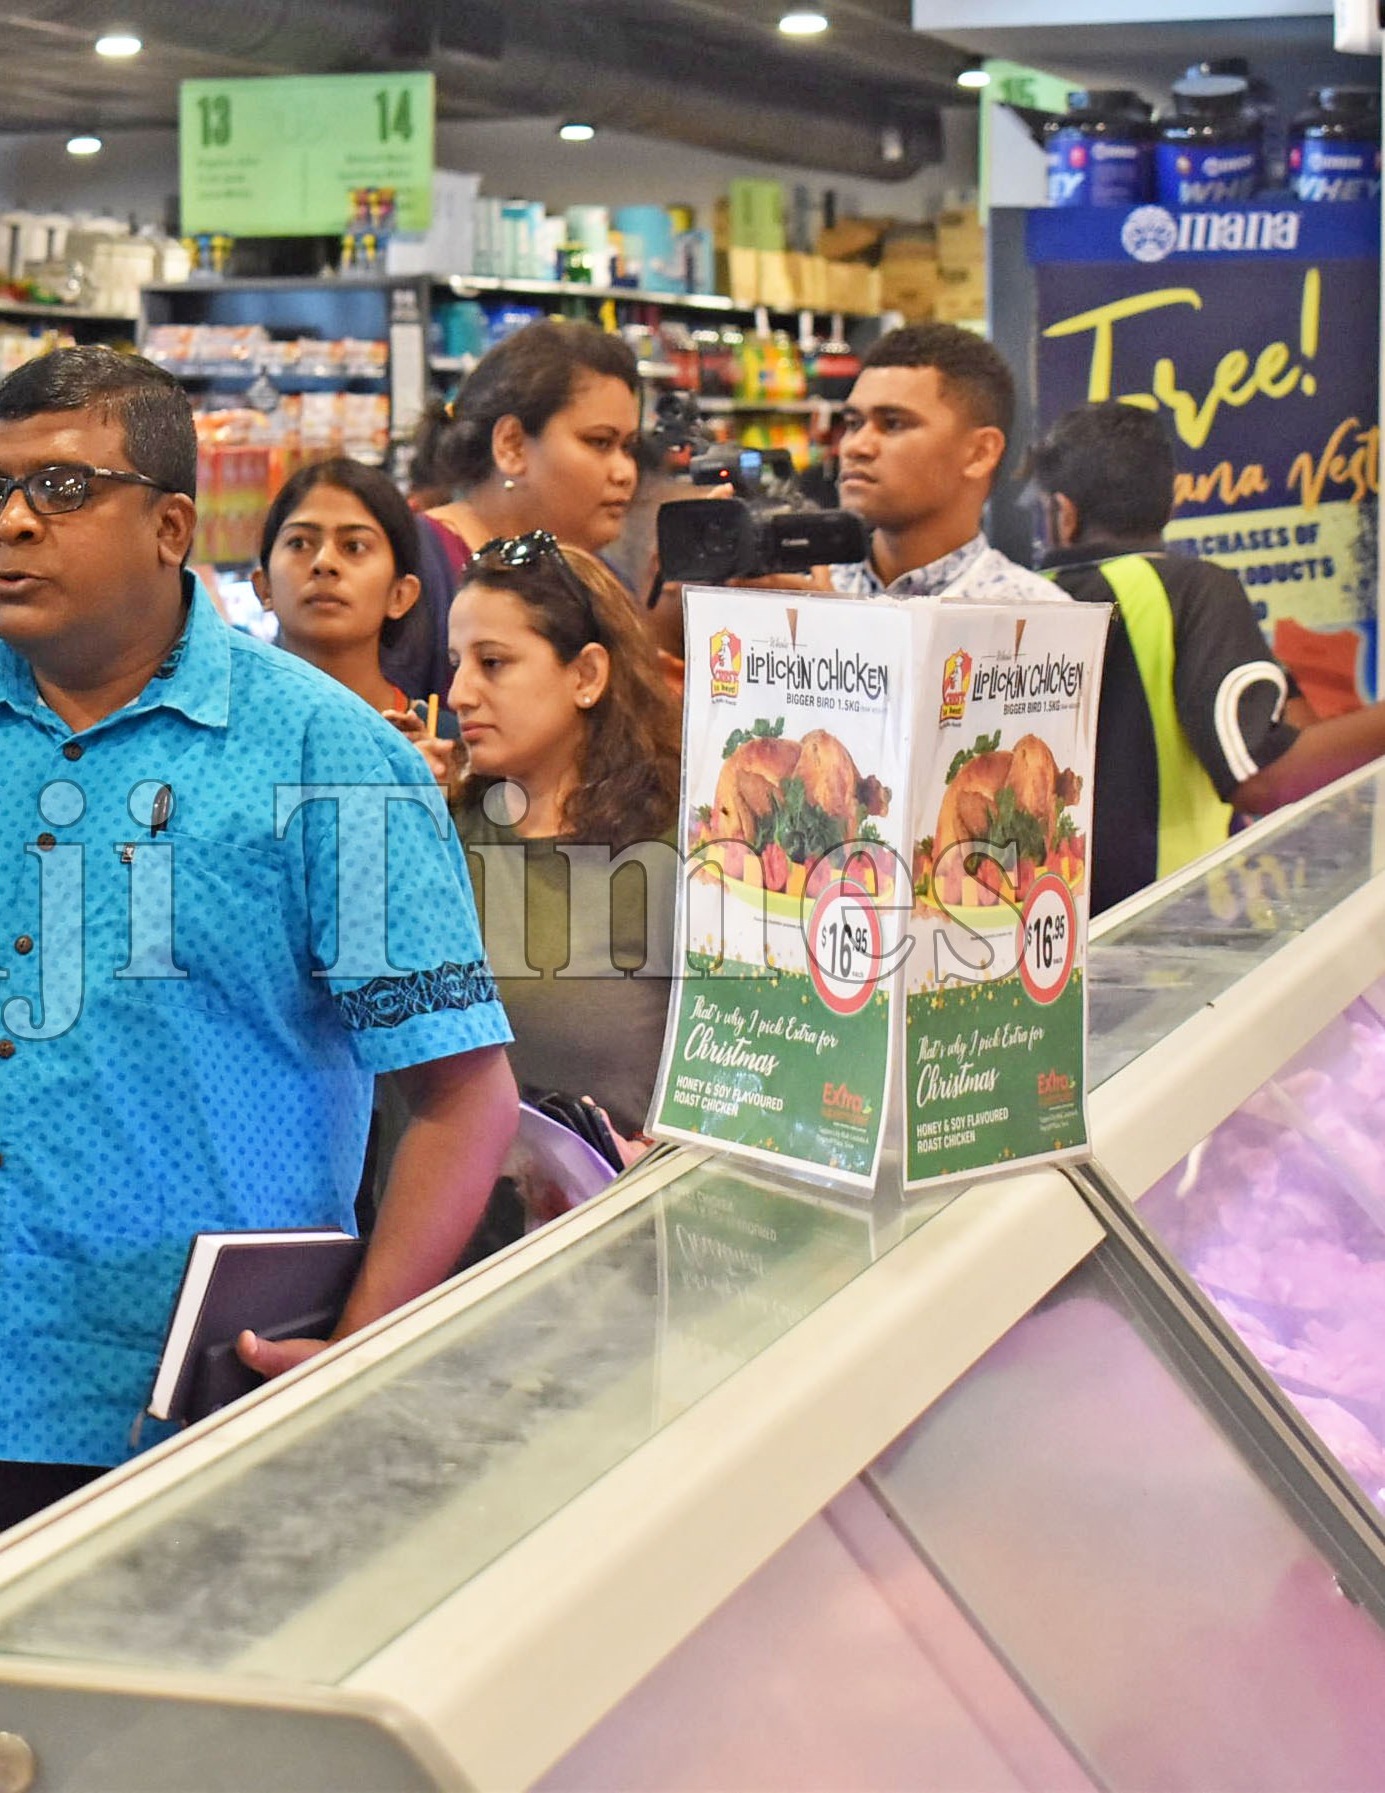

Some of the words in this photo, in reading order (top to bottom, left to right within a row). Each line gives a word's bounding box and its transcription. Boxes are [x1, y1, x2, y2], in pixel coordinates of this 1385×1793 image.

[197, 96, 231, 147] 13
[375, 89, 413, 143] 14
[1176, 210, 1300, 251] mana
[1295, 523, 1320, 545] OF
[817, 647, 889, 700] CHICKEN
[1030, 652, 1084, 697] CHICKEN
[786, 693, 815, 707] BIGGER
[816, 696, 836, 710] BIRD
[838, 698, 860, 713] 1.5KG
[1003, 703, 1026, 716] BIGGER
[1027, 701, 1042, 714] BIRD
[1043, 699, 1060, 713] 1.5KG
[688, 994, 722, 1025] That's
[723, 1006, 747, 1036] why
[747, 1009, 760, 1032] I
[757, 1016, 784, 1039] pick
[785, 1016, 818, 1043] Extra
[815, 1028, 839, 1056] for
[916, 1034, 946, 1065] That's
[947, 1033, 968, 1064] why
[968, 1029, 980, 1056] I
[977, 1026, 1001, 1057] pick
[1001, 1022, 1029, 1048] Extra
[1027, 1025, 1046, 1051] for
[683, 1022, 780, 1077] Christmas
[673, 1089, 701, 1109] ROAST
[701, 1096, 740, 1117] CHICKEN
[676, 1074, 704, 1093] HONEY
[705, 1081, 712, 1095] &
[712, 1082, 732, 1098] SOY
[732, 1087, 784, 1112] FLAVOURED
[916, 1061, 1000, 1108] Christmas
[916, 1121, 942, 1138] HONEY
[943, 1121, 950, 1132] &
[951, 1116, 966, 1131] SOY
[967, 1106, 1010, 1128] FLAVOURED
[917, 1137, 943, 1154] ROAST
[943, 1129, 977, 1149] CHICKEN
